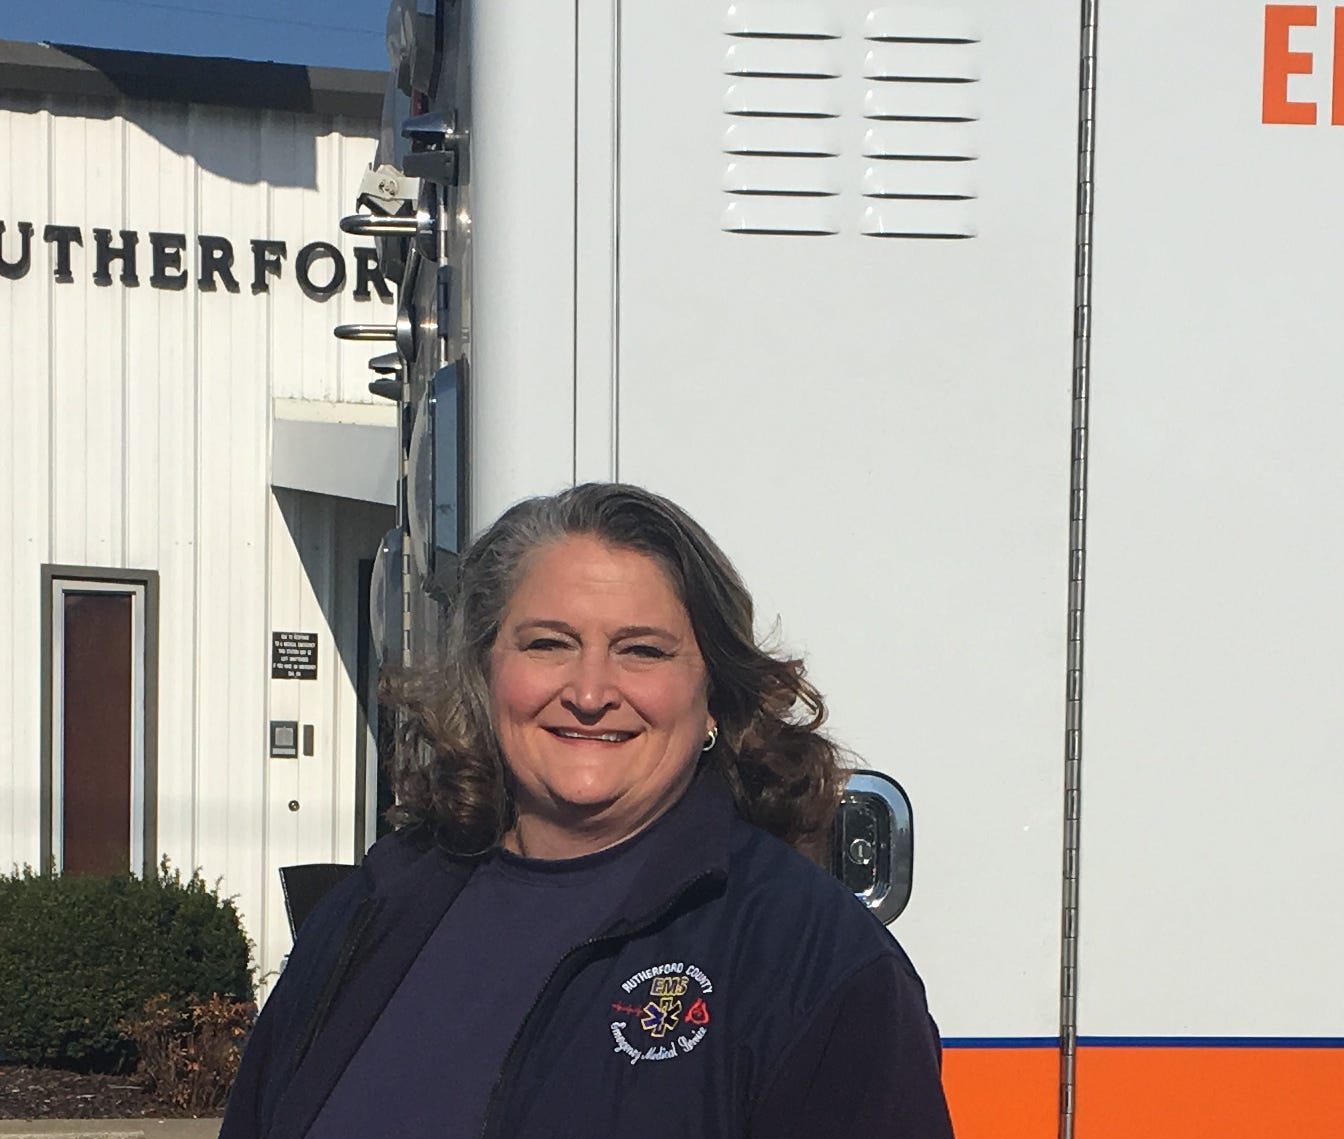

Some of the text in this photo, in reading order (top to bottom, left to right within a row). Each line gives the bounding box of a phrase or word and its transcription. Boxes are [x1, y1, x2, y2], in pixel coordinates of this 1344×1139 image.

[621, 962, 713, 994] RUTHERFORD COUNTY
[650, 976, 690, 996] EMS
[610, 1021, 642, 1065] Emergency
[641, 1041, 678, 1060] Medical
